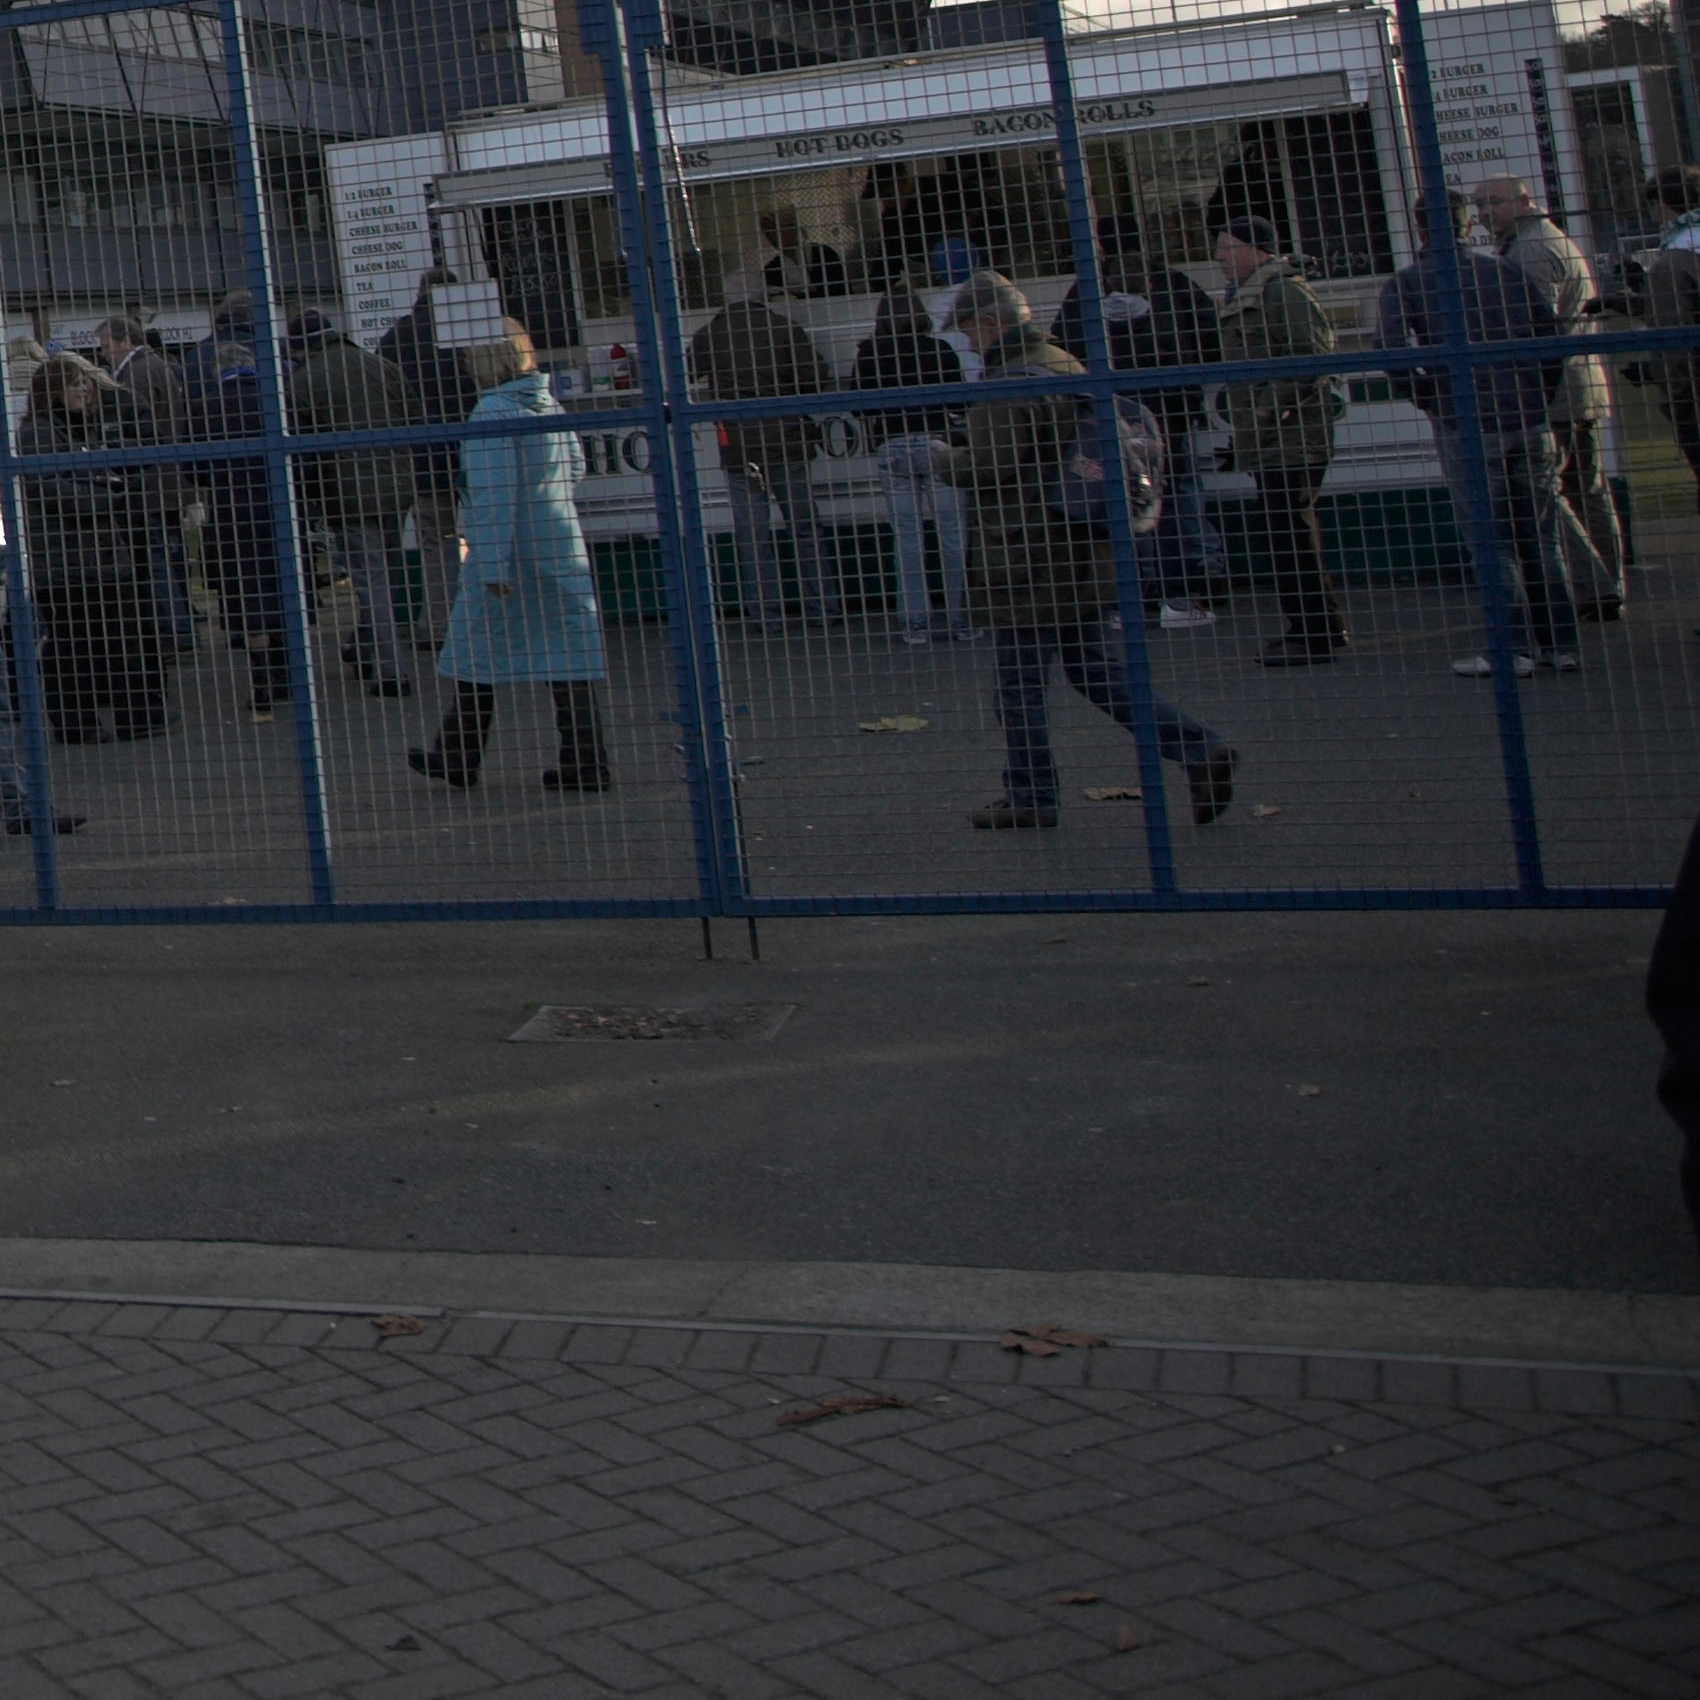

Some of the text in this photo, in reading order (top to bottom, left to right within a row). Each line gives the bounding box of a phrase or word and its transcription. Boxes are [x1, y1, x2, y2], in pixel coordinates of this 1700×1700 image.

[1436, 102, 1518, 121] HEESE BURGER
[775, 137, 826, 158] HOT
[835, 129, 904, 151] DOGS
[973, 111, 1057, 136] BACON
[1439, 126, 1499, 141] HEESE DOG
[1443, 150, 1473, 164] ACON
[1446, 172, 1461, 185] EA
[349, 221, 418, 237] CHEESE BURGER
[352, 241, 403, 255] CHEESE DOG
[356, 282, 374, 291] TEA
[358, 298, 390, 310] COFFEE
